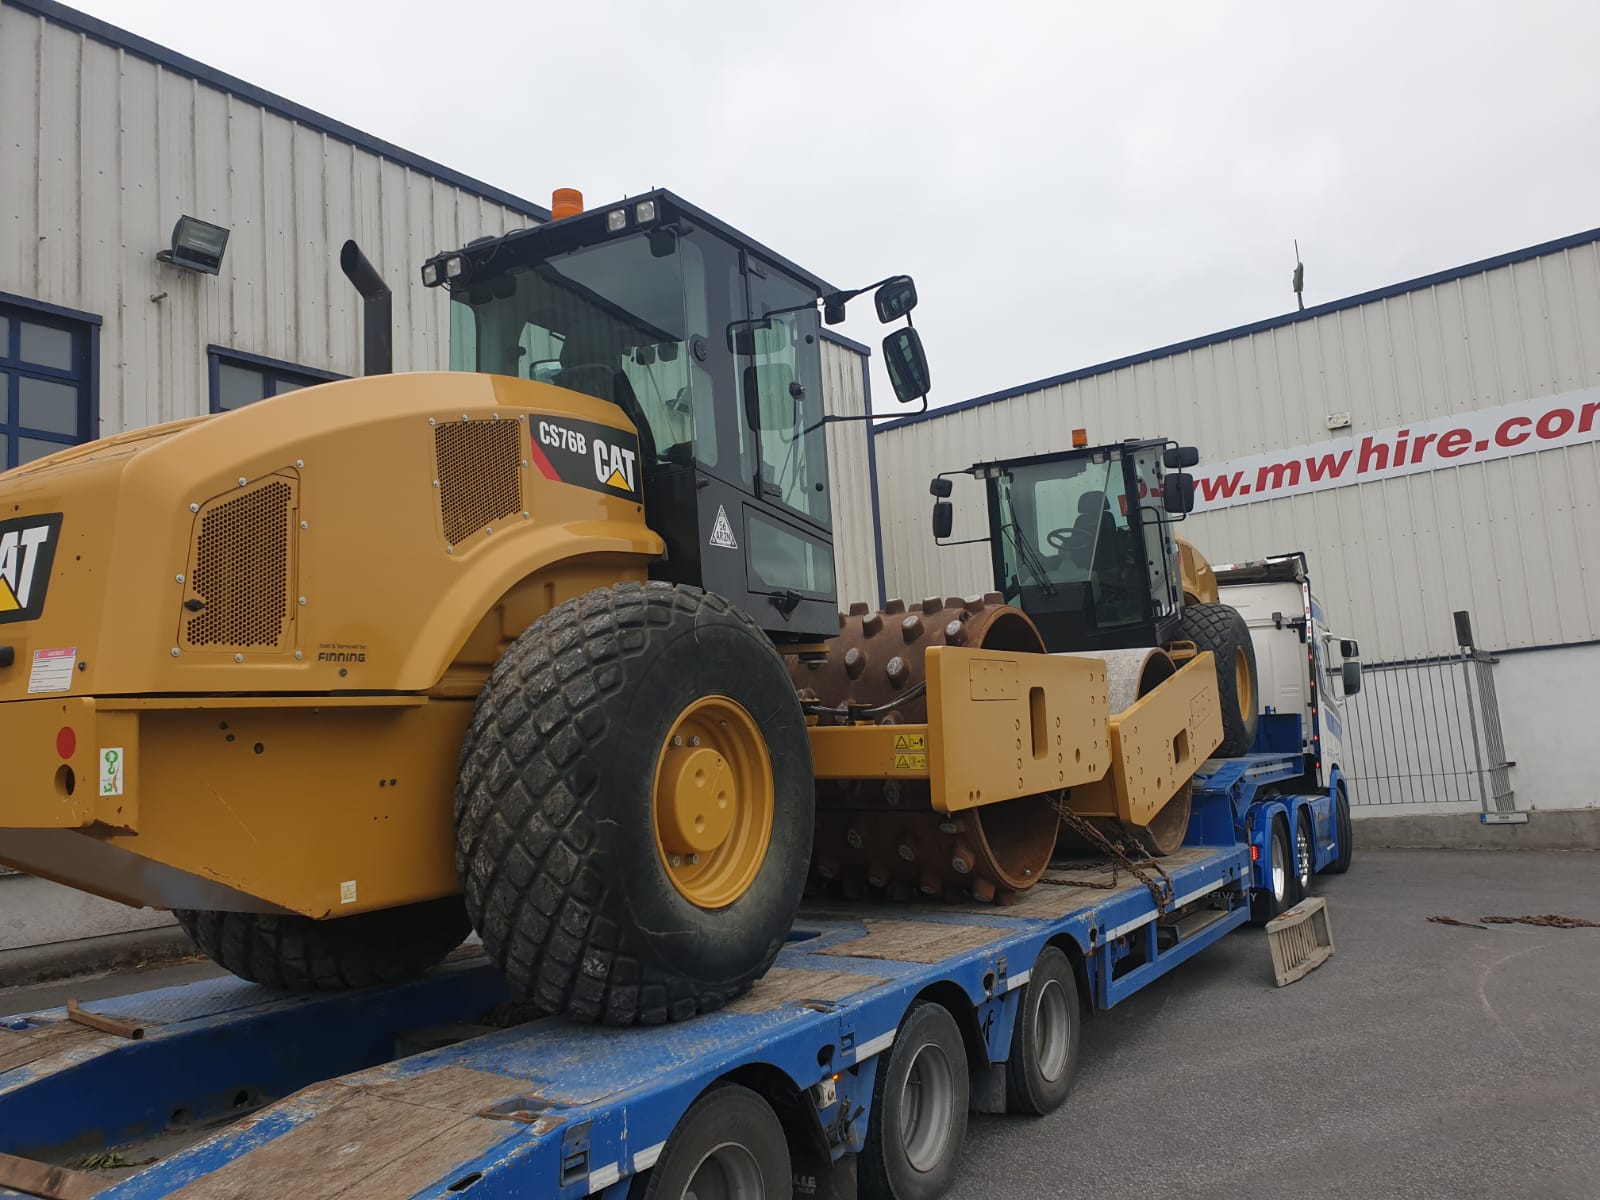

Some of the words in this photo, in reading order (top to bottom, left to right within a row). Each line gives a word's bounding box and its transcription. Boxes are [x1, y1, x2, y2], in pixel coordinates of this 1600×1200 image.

[539, 421, 587, 455] CS76B
[593, 439, 635, 493] CAT
[318, 652, 366, 663] FINNING
